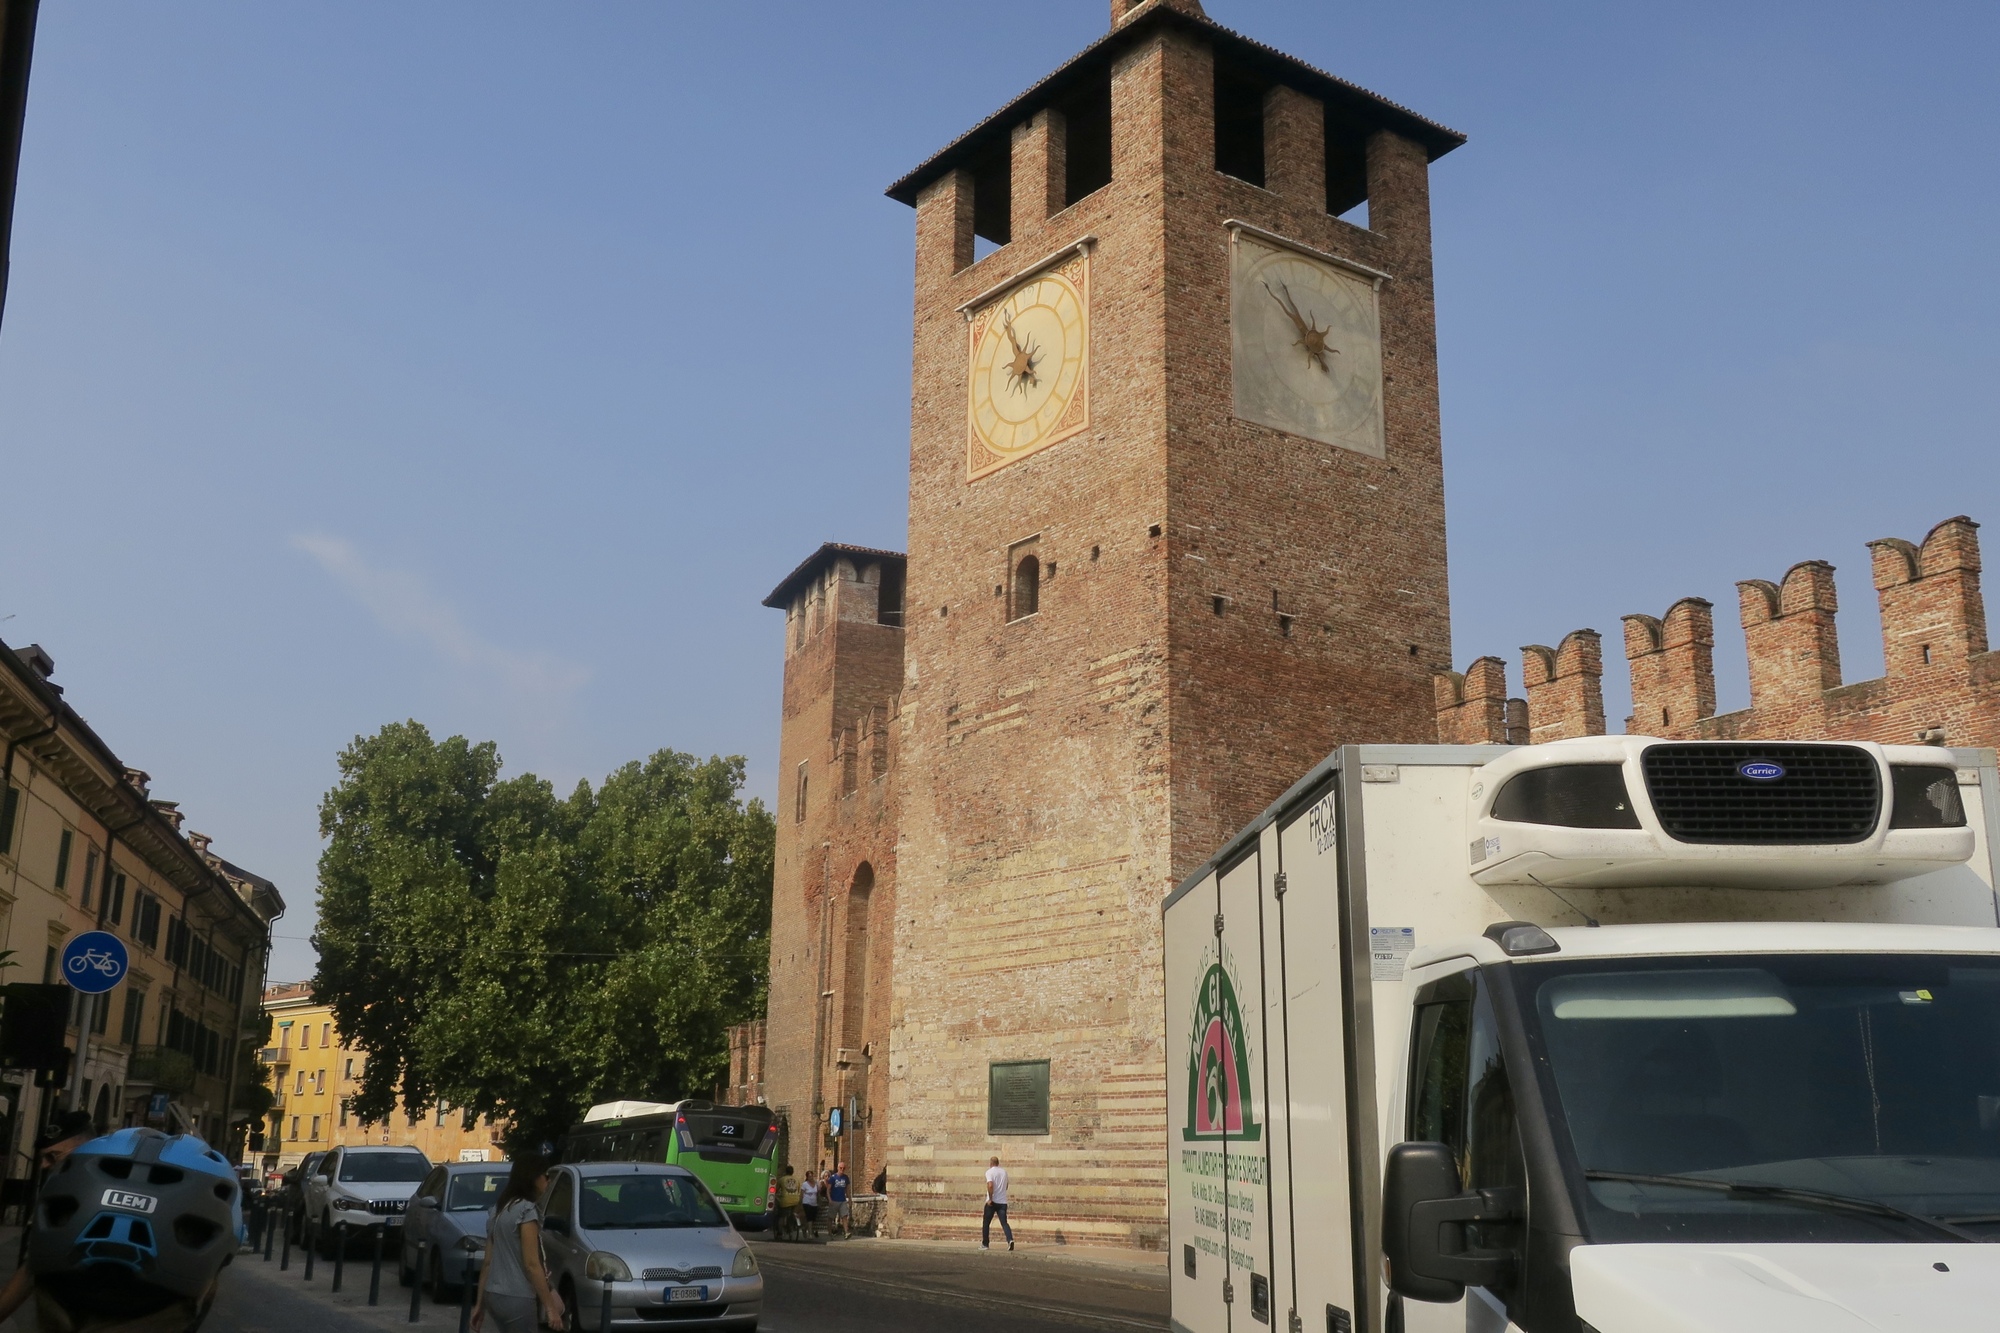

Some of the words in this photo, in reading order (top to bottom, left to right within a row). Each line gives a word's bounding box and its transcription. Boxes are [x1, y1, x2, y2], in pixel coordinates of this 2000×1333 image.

[1746, 767, 1777, 775] Carrier
[1310, 792, 1335, 842] FRCX
[1212, 938, 1254, 1072] ALMENTARE
[721, 1125, 735, 1135] 22
[1182, 1149, 1197, 1173] PRODOTTI
[1198, 1151, 1218, 1177] ALIMENTARI
[111, 1193, 147, 1209] LEM
